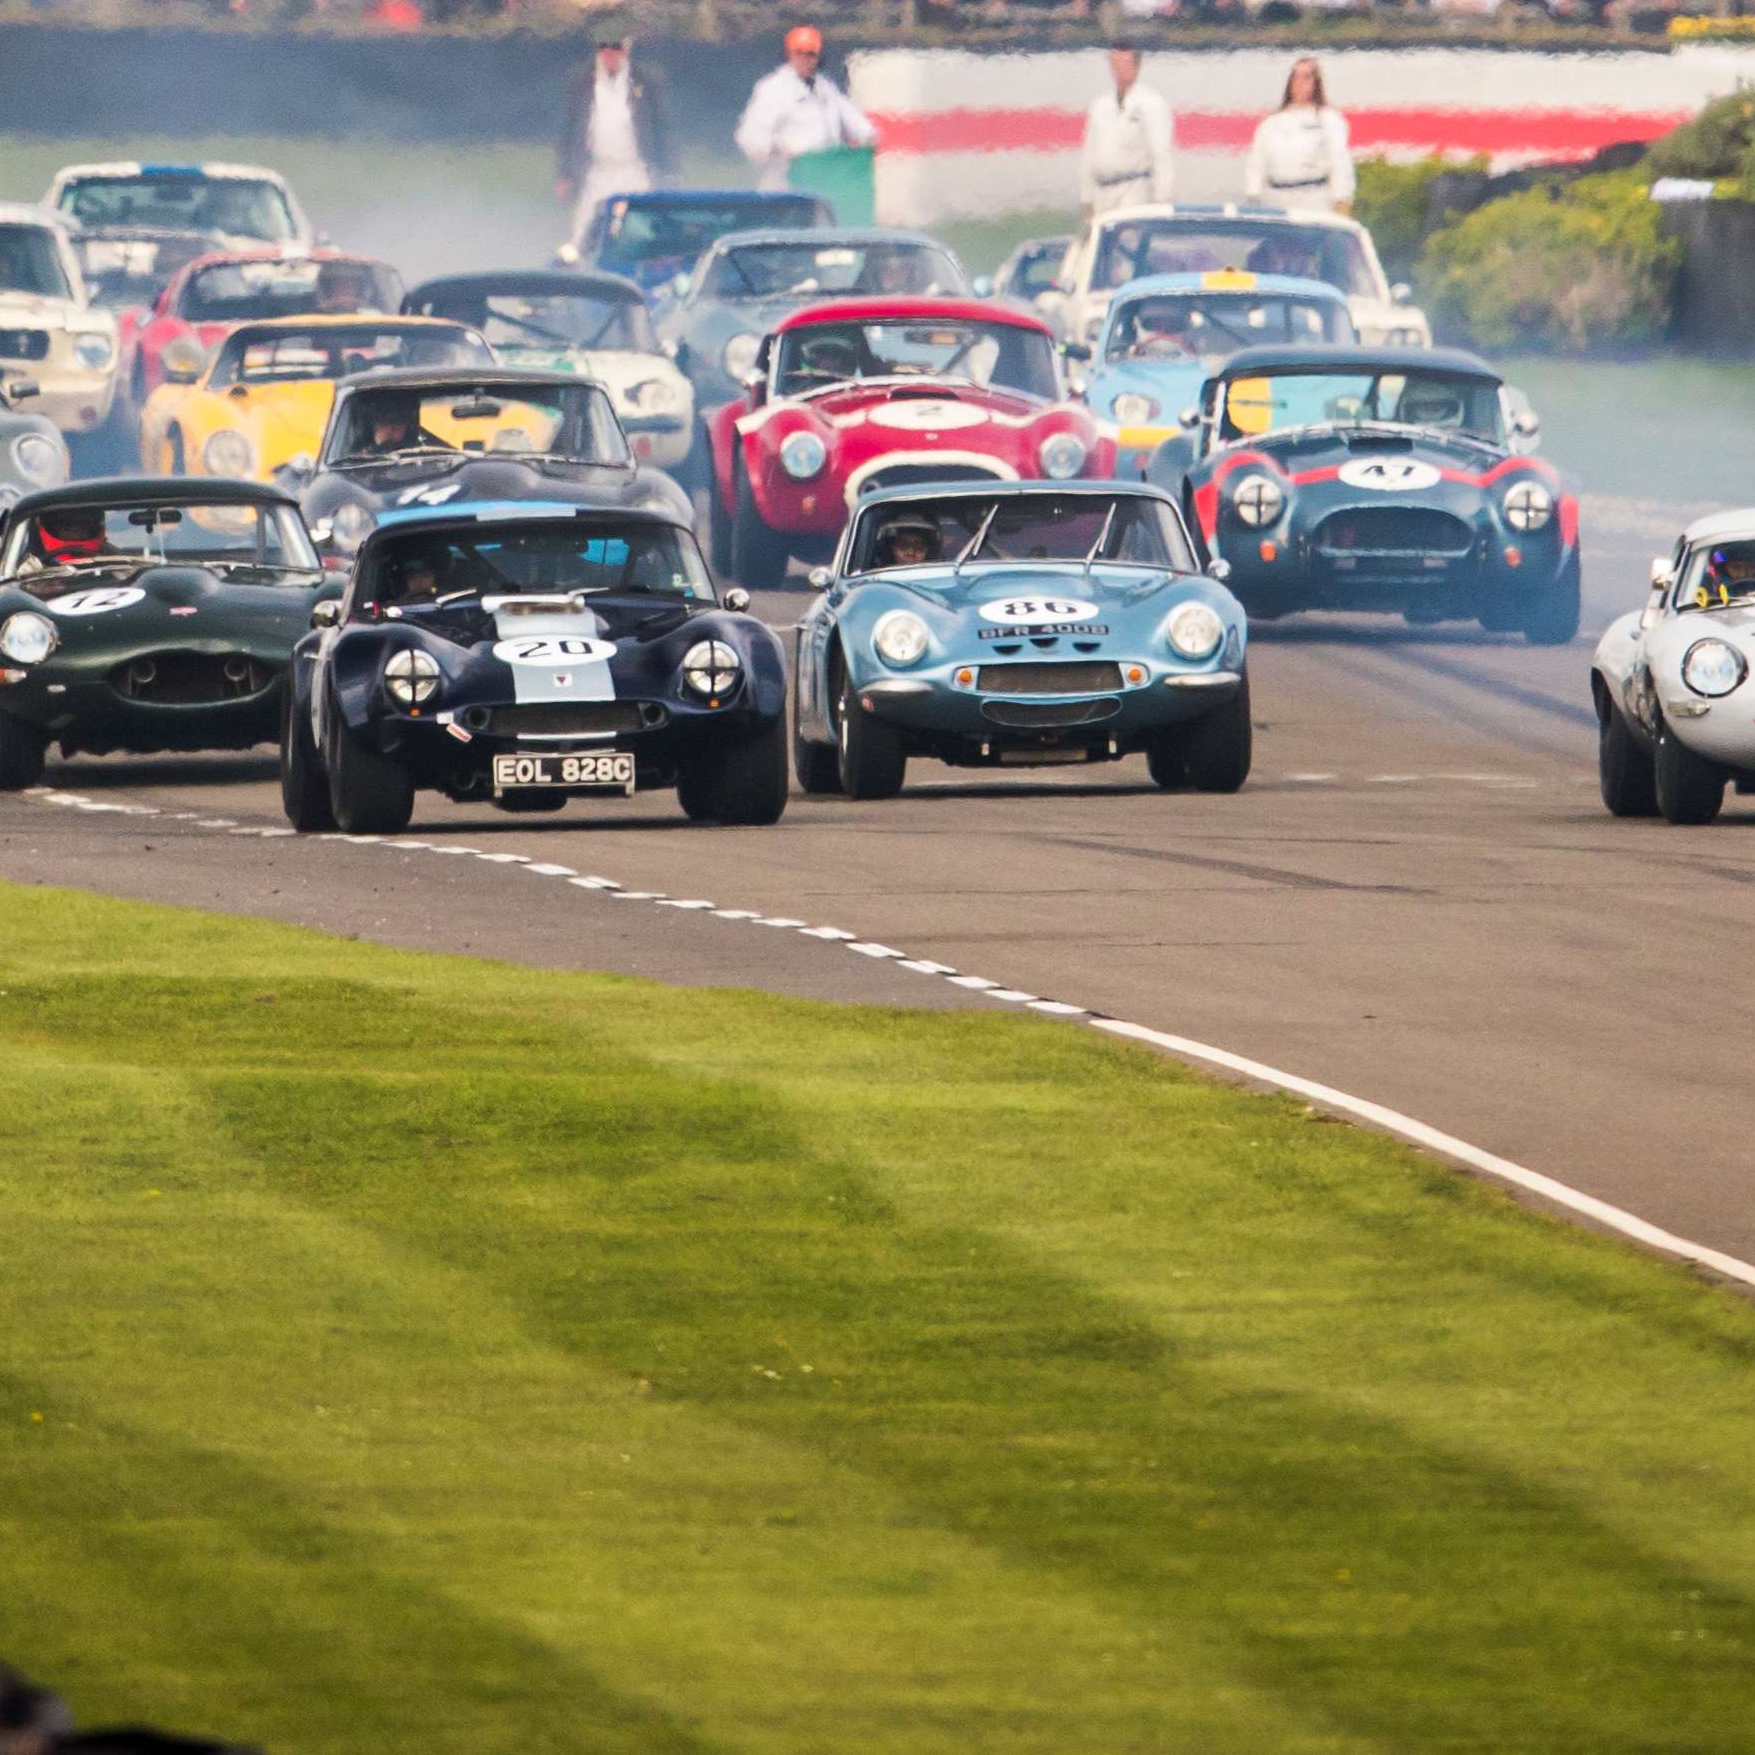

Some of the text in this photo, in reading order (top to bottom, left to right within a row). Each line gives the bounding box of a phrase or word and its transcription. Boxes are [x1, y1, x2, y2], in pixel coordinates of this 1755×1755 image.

[514, 640, 593, 658] 20
[498, 757, 631, 783] EOL 828C
